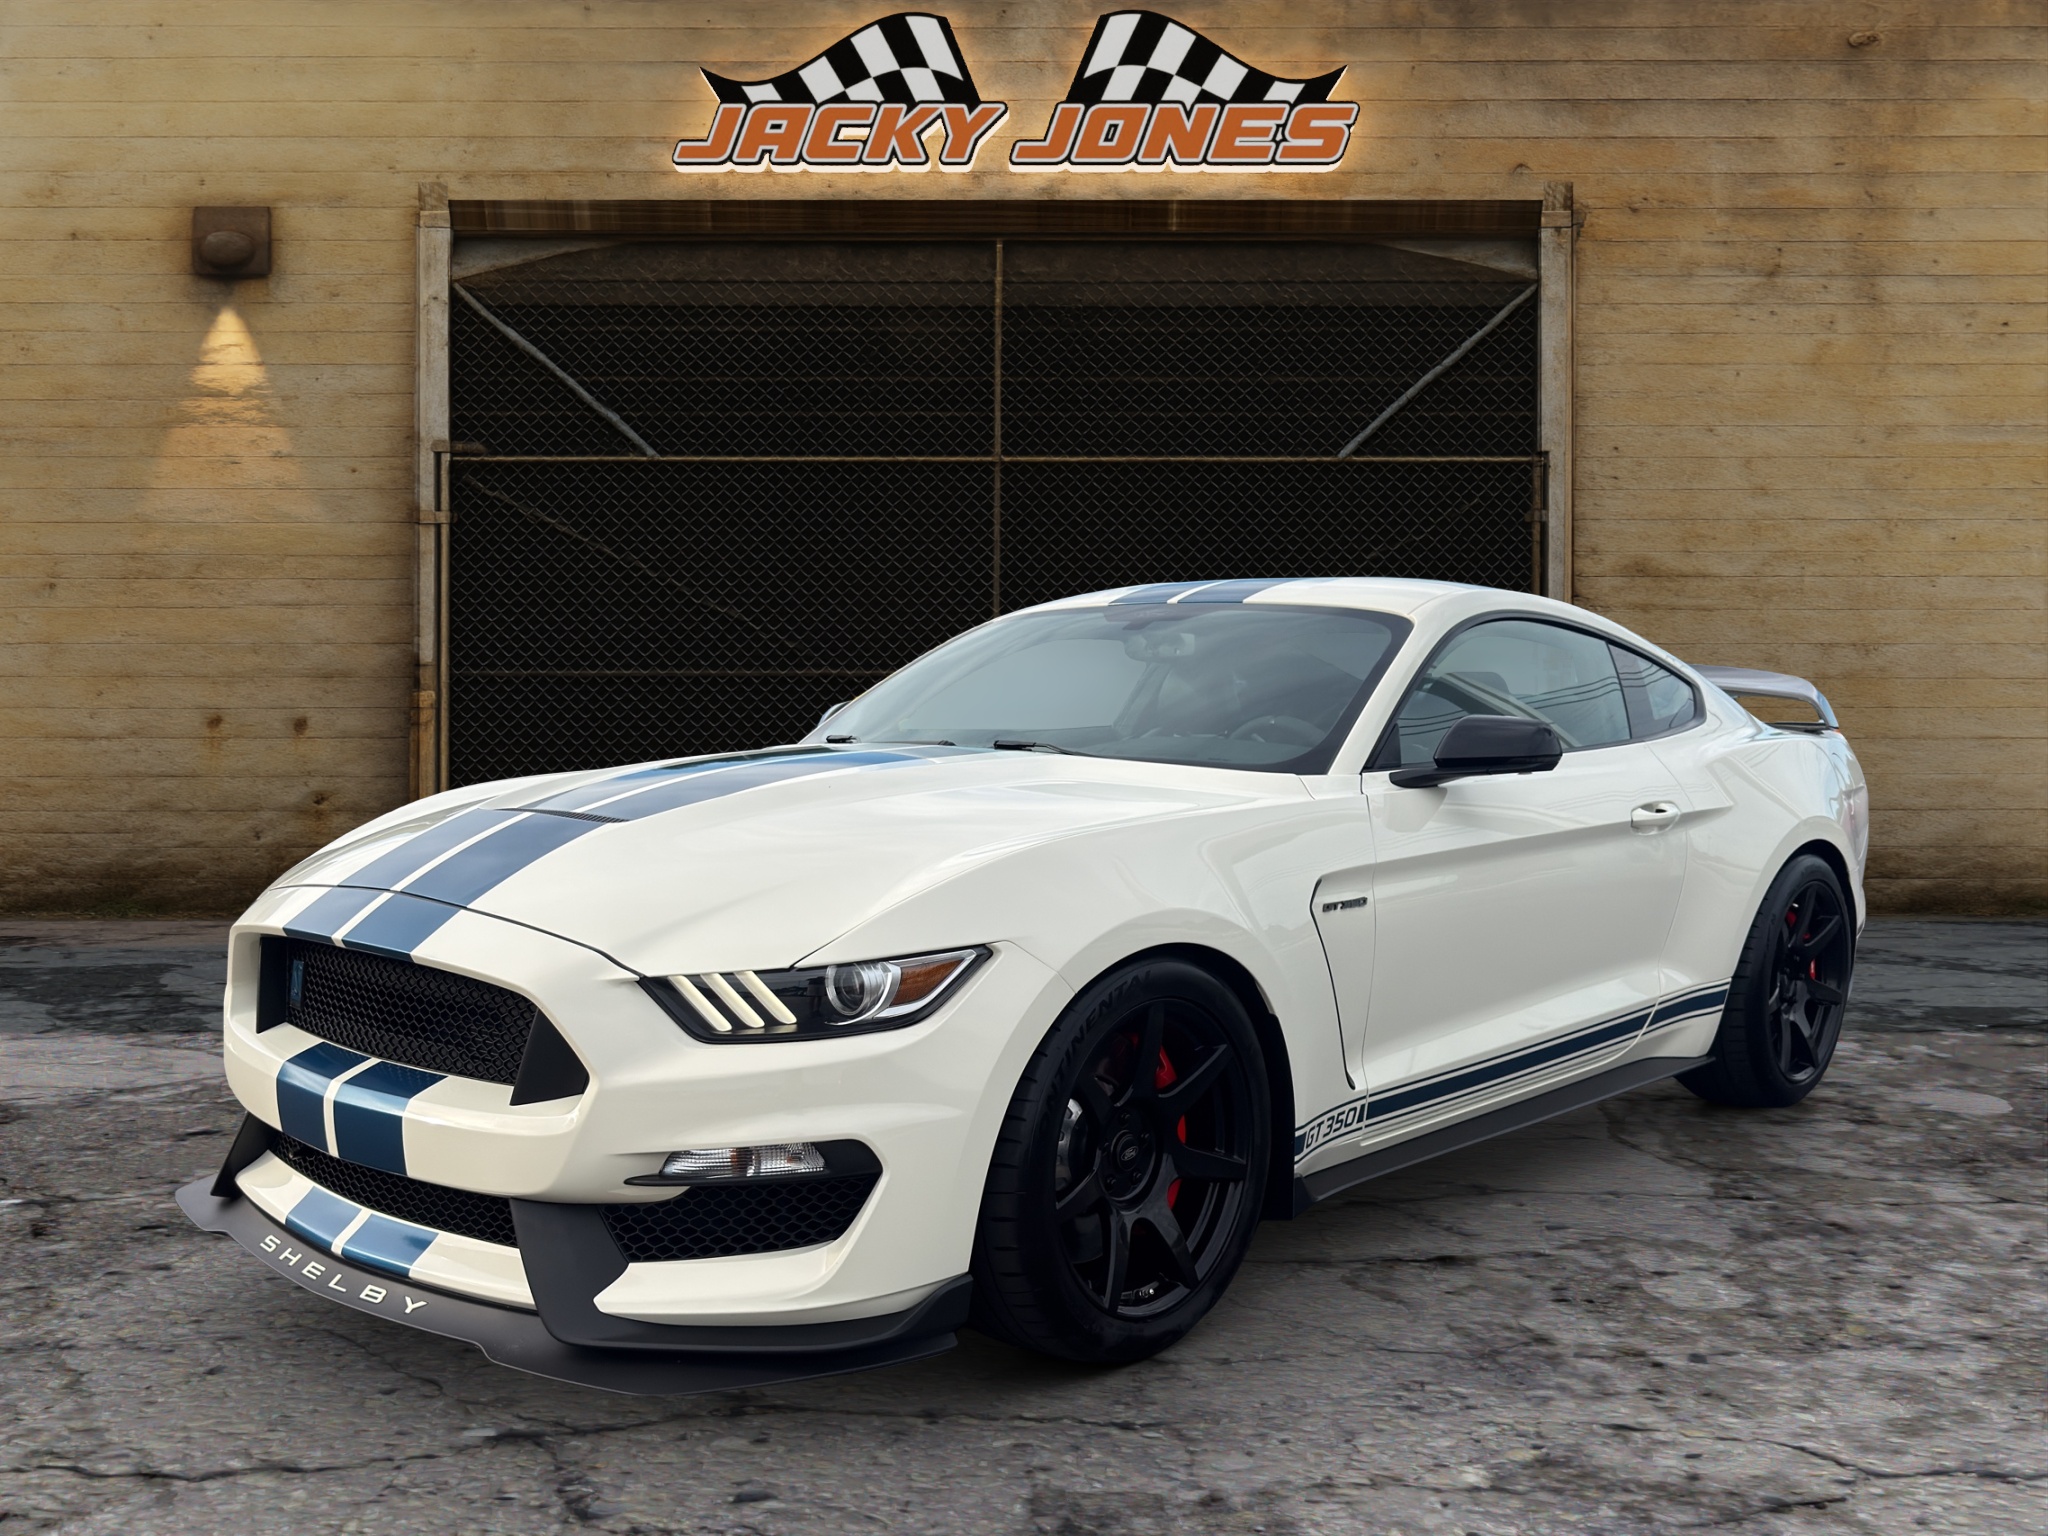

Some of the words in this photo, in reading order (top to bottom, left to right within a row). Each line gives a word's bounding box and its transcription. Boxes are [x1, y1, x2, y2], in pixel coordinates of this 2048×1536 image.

[673, 101, 1008, 167] JACKY
[1009, 101, 1360, 167] JONES
[1305, 1106, 1357, 1149] GT350
[259, 1234, 428, 1314] SHELBY
